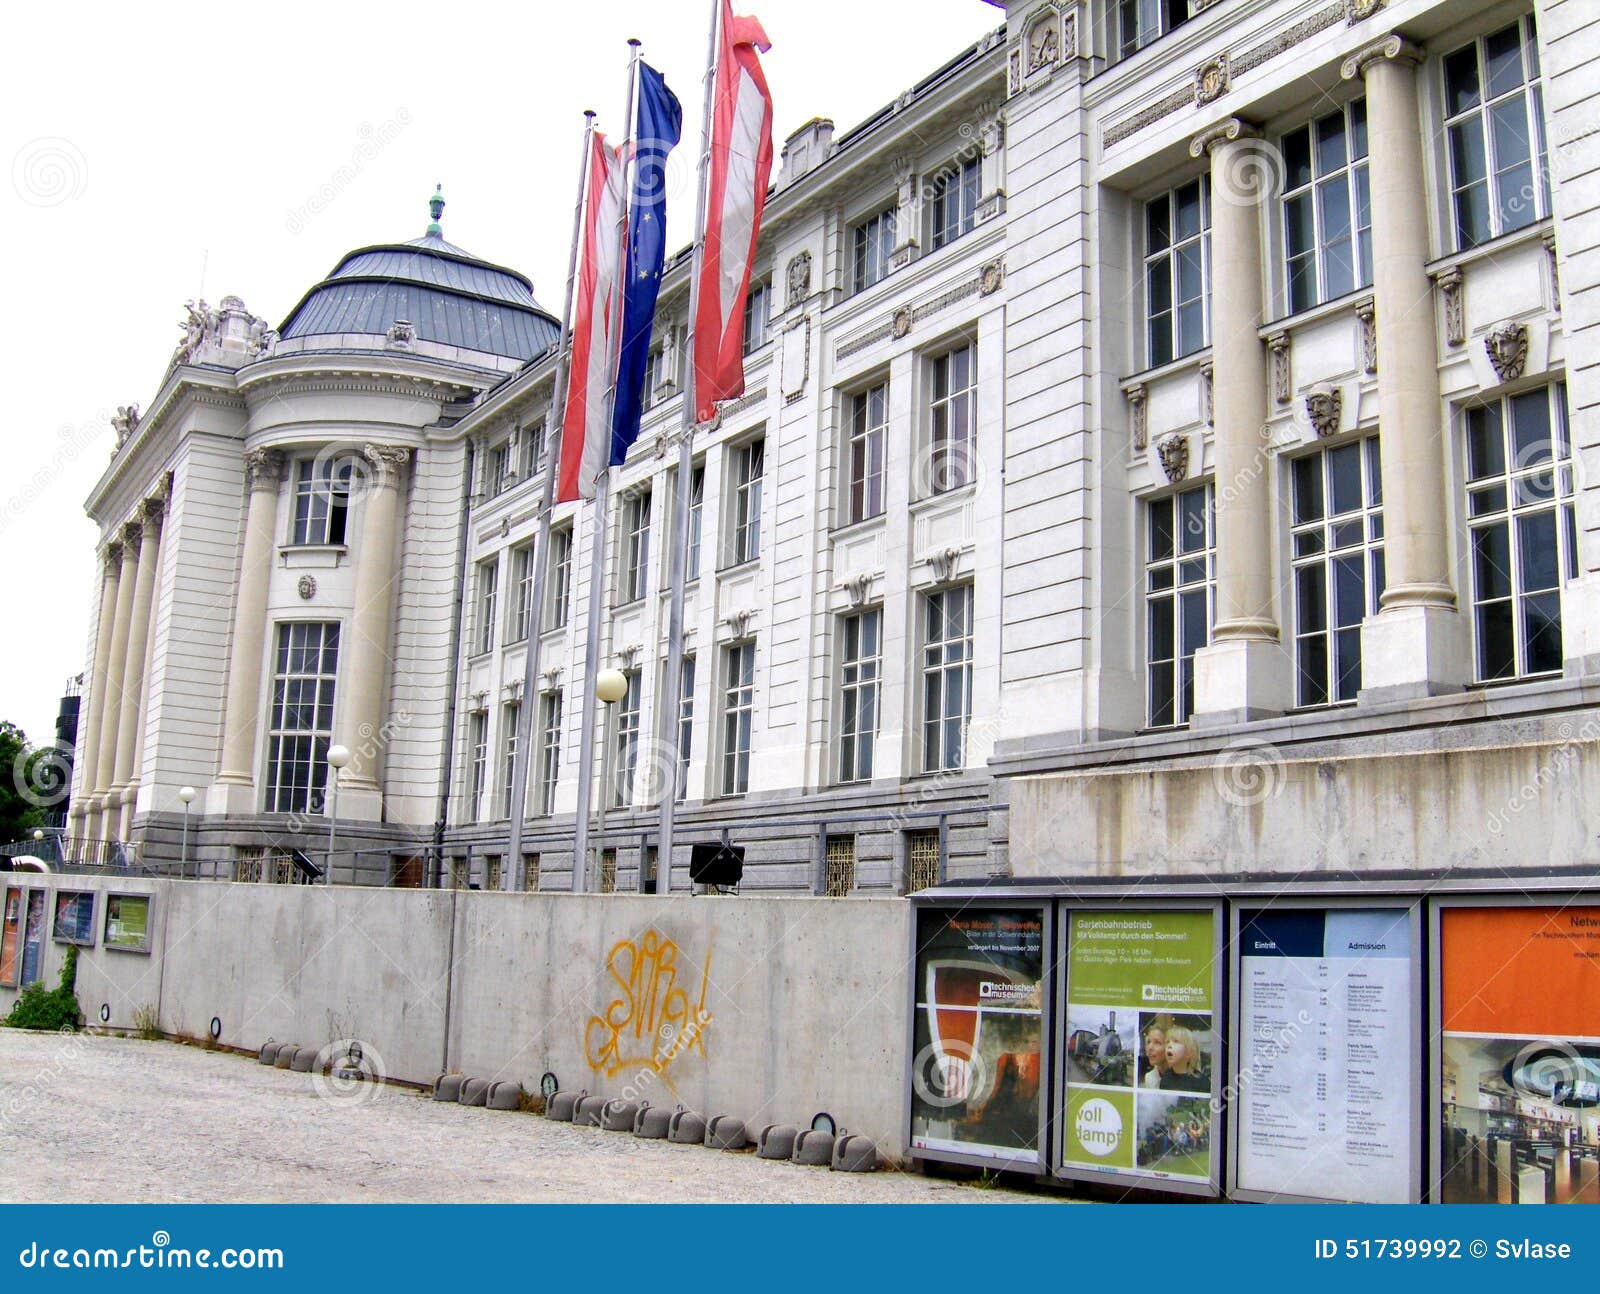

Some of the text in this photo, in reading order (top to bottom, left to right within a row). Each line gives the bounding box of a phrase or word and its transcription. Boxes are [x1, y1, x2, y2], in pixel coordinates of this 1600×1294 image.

[1077, 919, 1153, 930] Gartenbahnbetrieb
[1570, 916, 1600, 928] Netw
[1254, 940, 1277, 950] Eintritt
[1347, 941, 1387, 951] Admission
[991, 982, 1035, 992] technisches
[1154, 984, 1204, 995] technisches
[991, 990, 1024, 999] museum
[1154, 994, 1190, 1002] museum
[1077, 1107, 1102, 1123] voll
